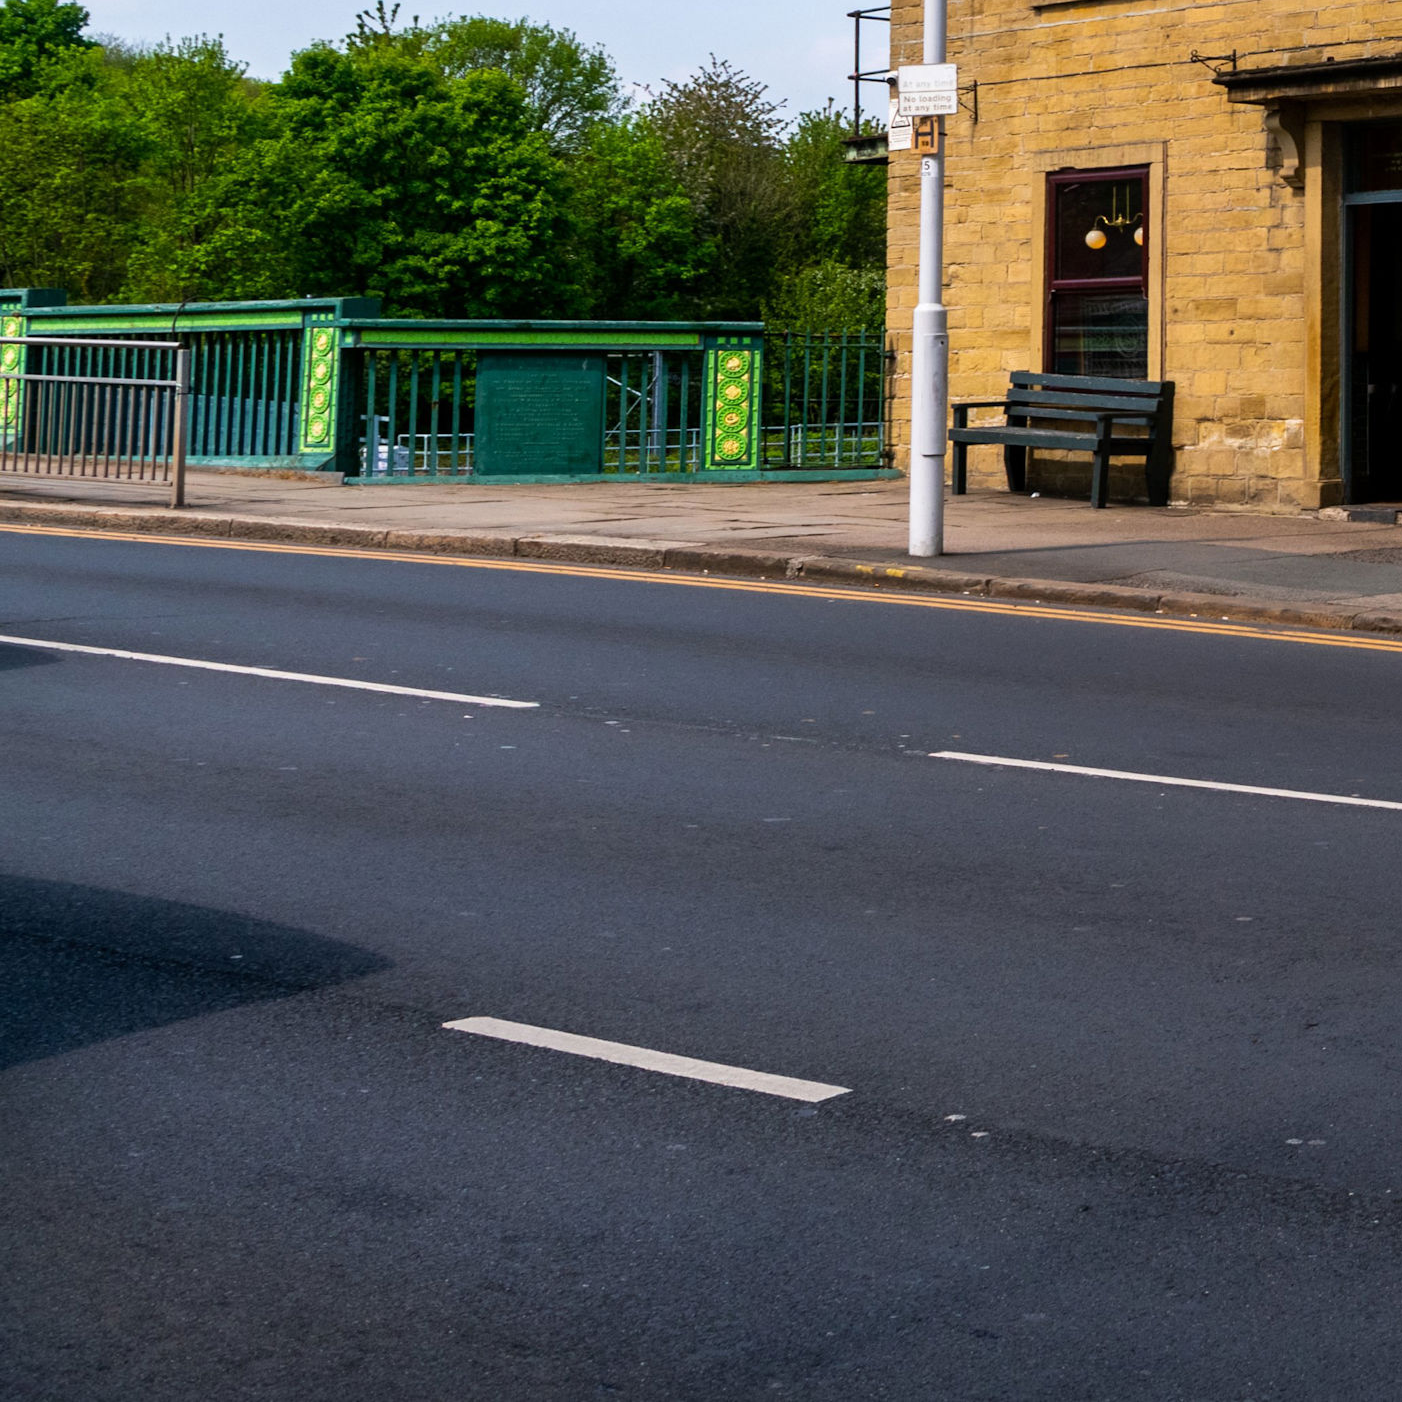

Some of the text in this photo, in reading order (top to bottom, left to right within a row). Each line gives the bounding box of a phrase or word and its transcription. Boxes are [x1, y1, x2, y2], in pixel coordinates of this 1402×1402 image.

[934, 78, 954, 87] time
[919, 94, 951, 103] loading
[915, 104, 930, 113] any
[934, 103, 953, 111] time
[924, 160, 930, 171] 5
